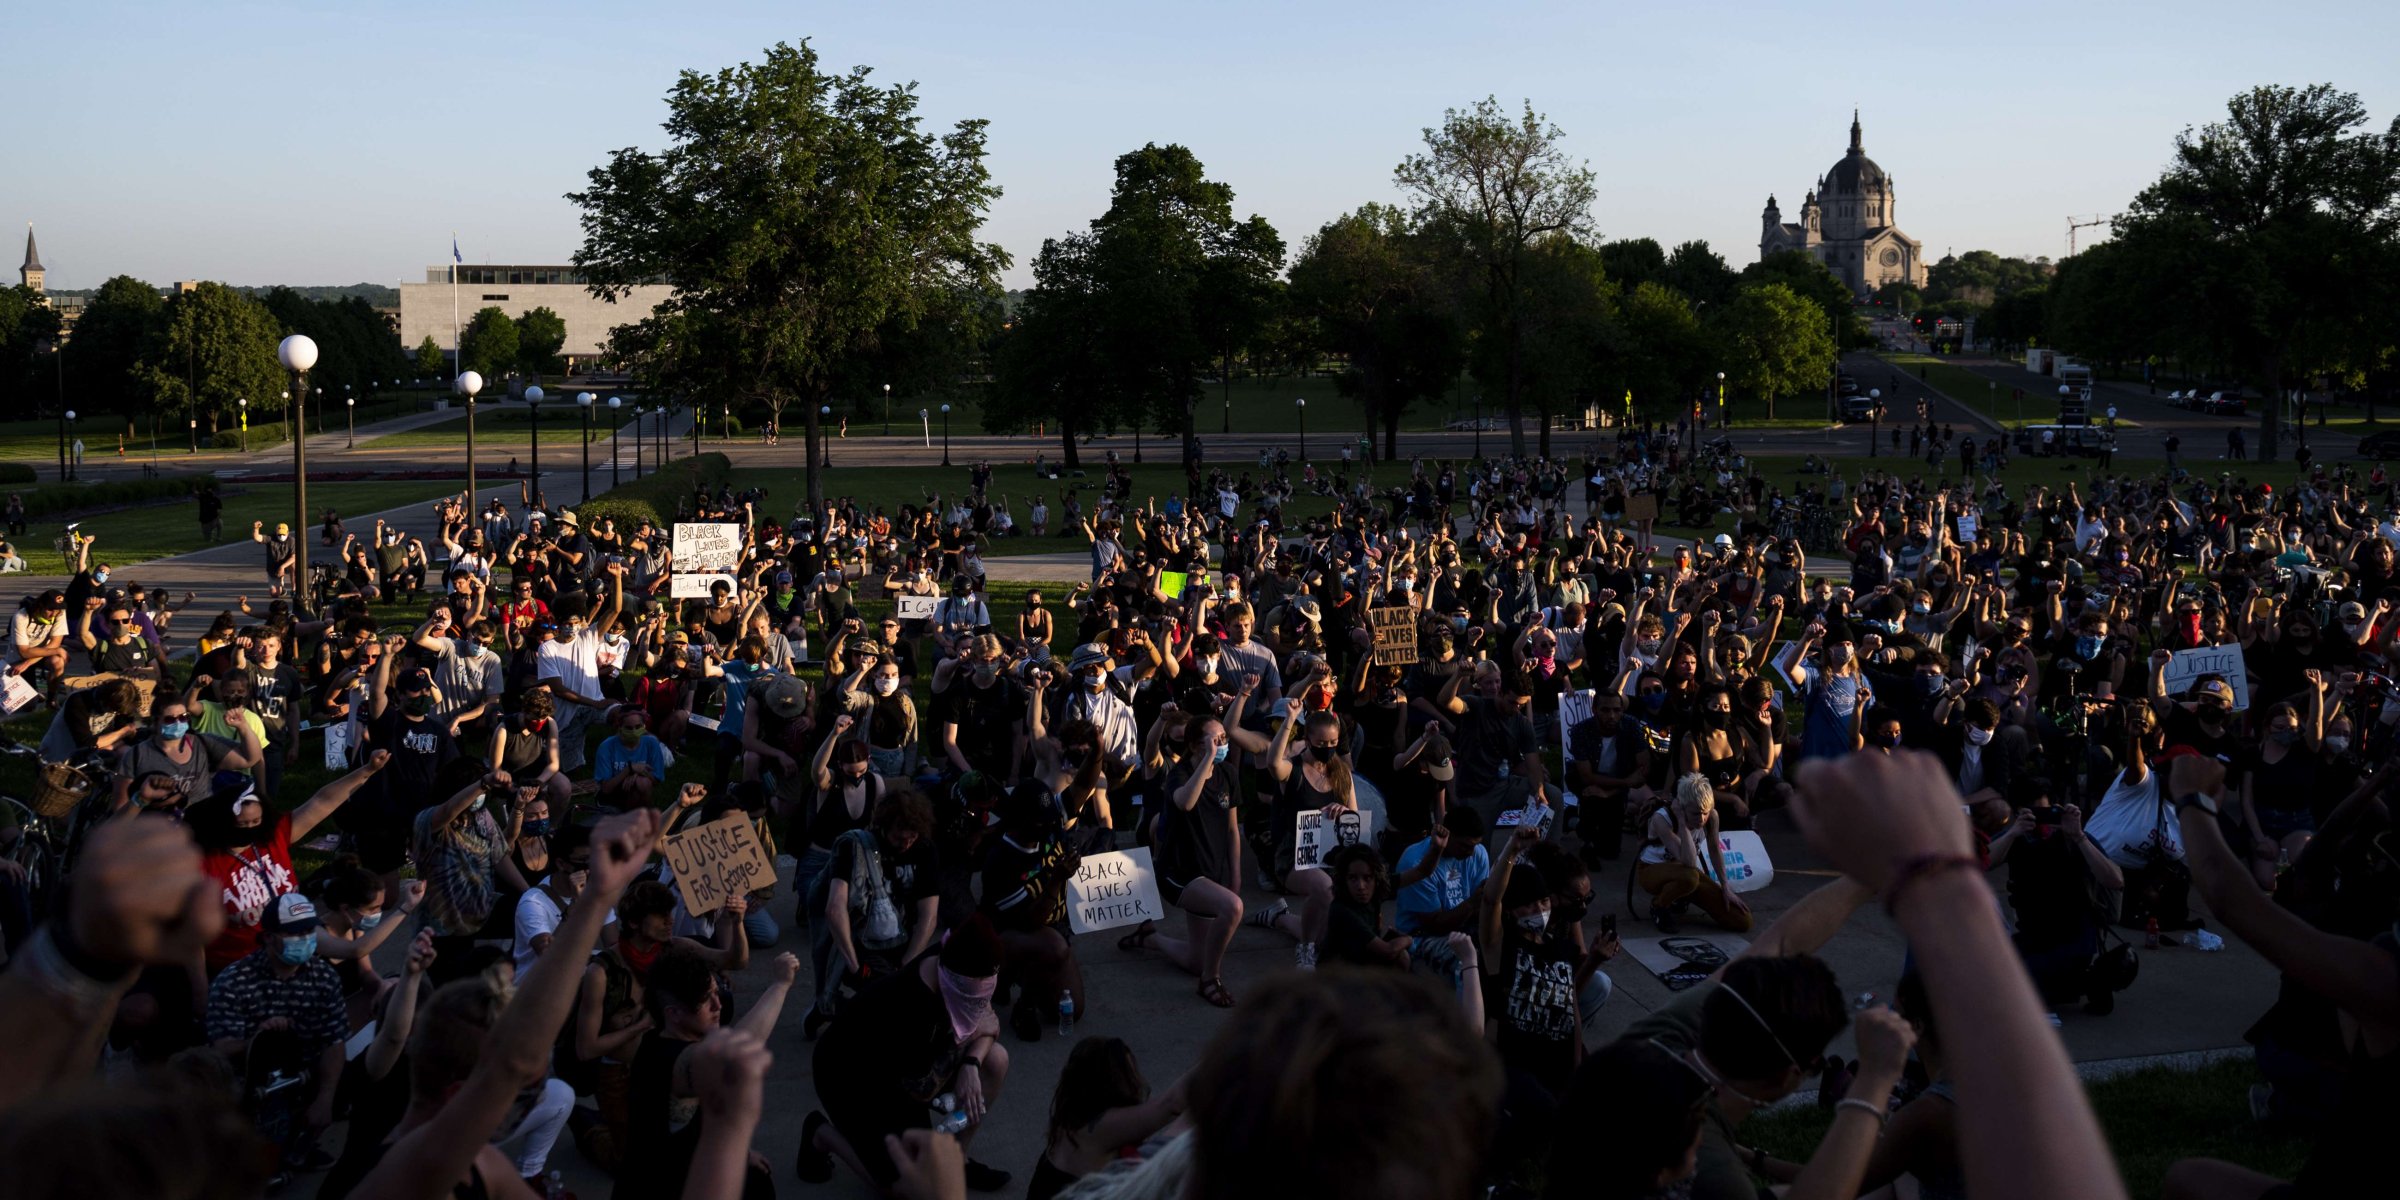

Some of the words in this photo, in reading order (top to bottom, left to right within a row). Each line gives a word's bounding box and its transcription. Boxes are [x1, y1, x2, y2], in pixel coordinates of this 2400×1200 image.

[679, 524, 722, 542] BLACK
[695, 538, 730, 553] LIVES
[699, 578, 708, 592] 4
[900, 600, 912, 612] I
[1374, 608, 1412, 627] BLACK
[1375, 648, 1416, 663] MATTER
[2181, 652, 2235, 674] JUSTICE
[1298, 813, 1322, 831] JUSTICE
[1303, 831, 1314, 845] FOR
[1296, 844, 1319, 866] GEORGE
[1076, 861, 1127, 883] BLACK
[1086, 880, 1132, 902] LIVES
[1084, 899, 1151, 924] MATTER.
